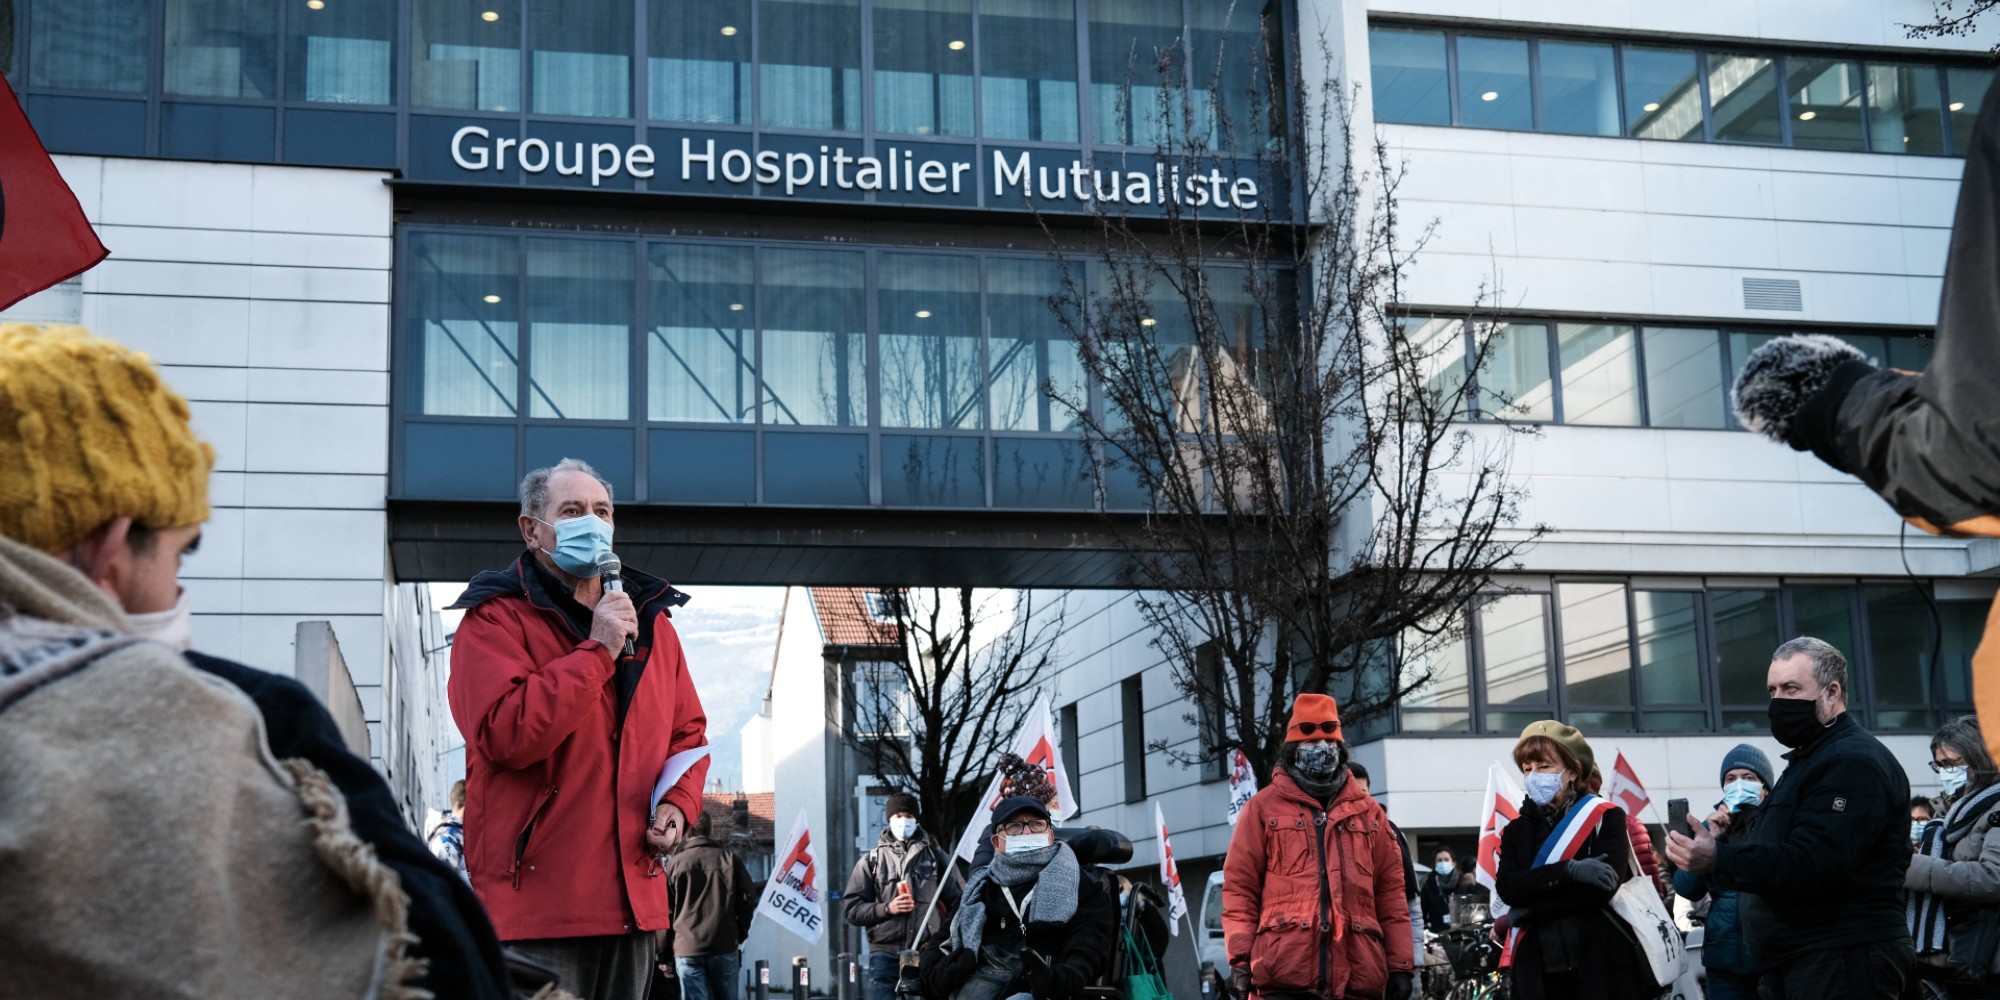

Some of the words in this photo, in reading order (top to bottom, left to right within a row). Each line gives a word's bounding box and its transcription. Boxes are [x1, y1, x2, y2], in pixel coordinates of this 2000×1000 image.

[451, 126, 656, 186] Groupe
[682, 138, 971, 195] Hospitalier
[994, 150, 1258, 210] Mutualiste
[768, 890, 822, 930] ISÈRE
